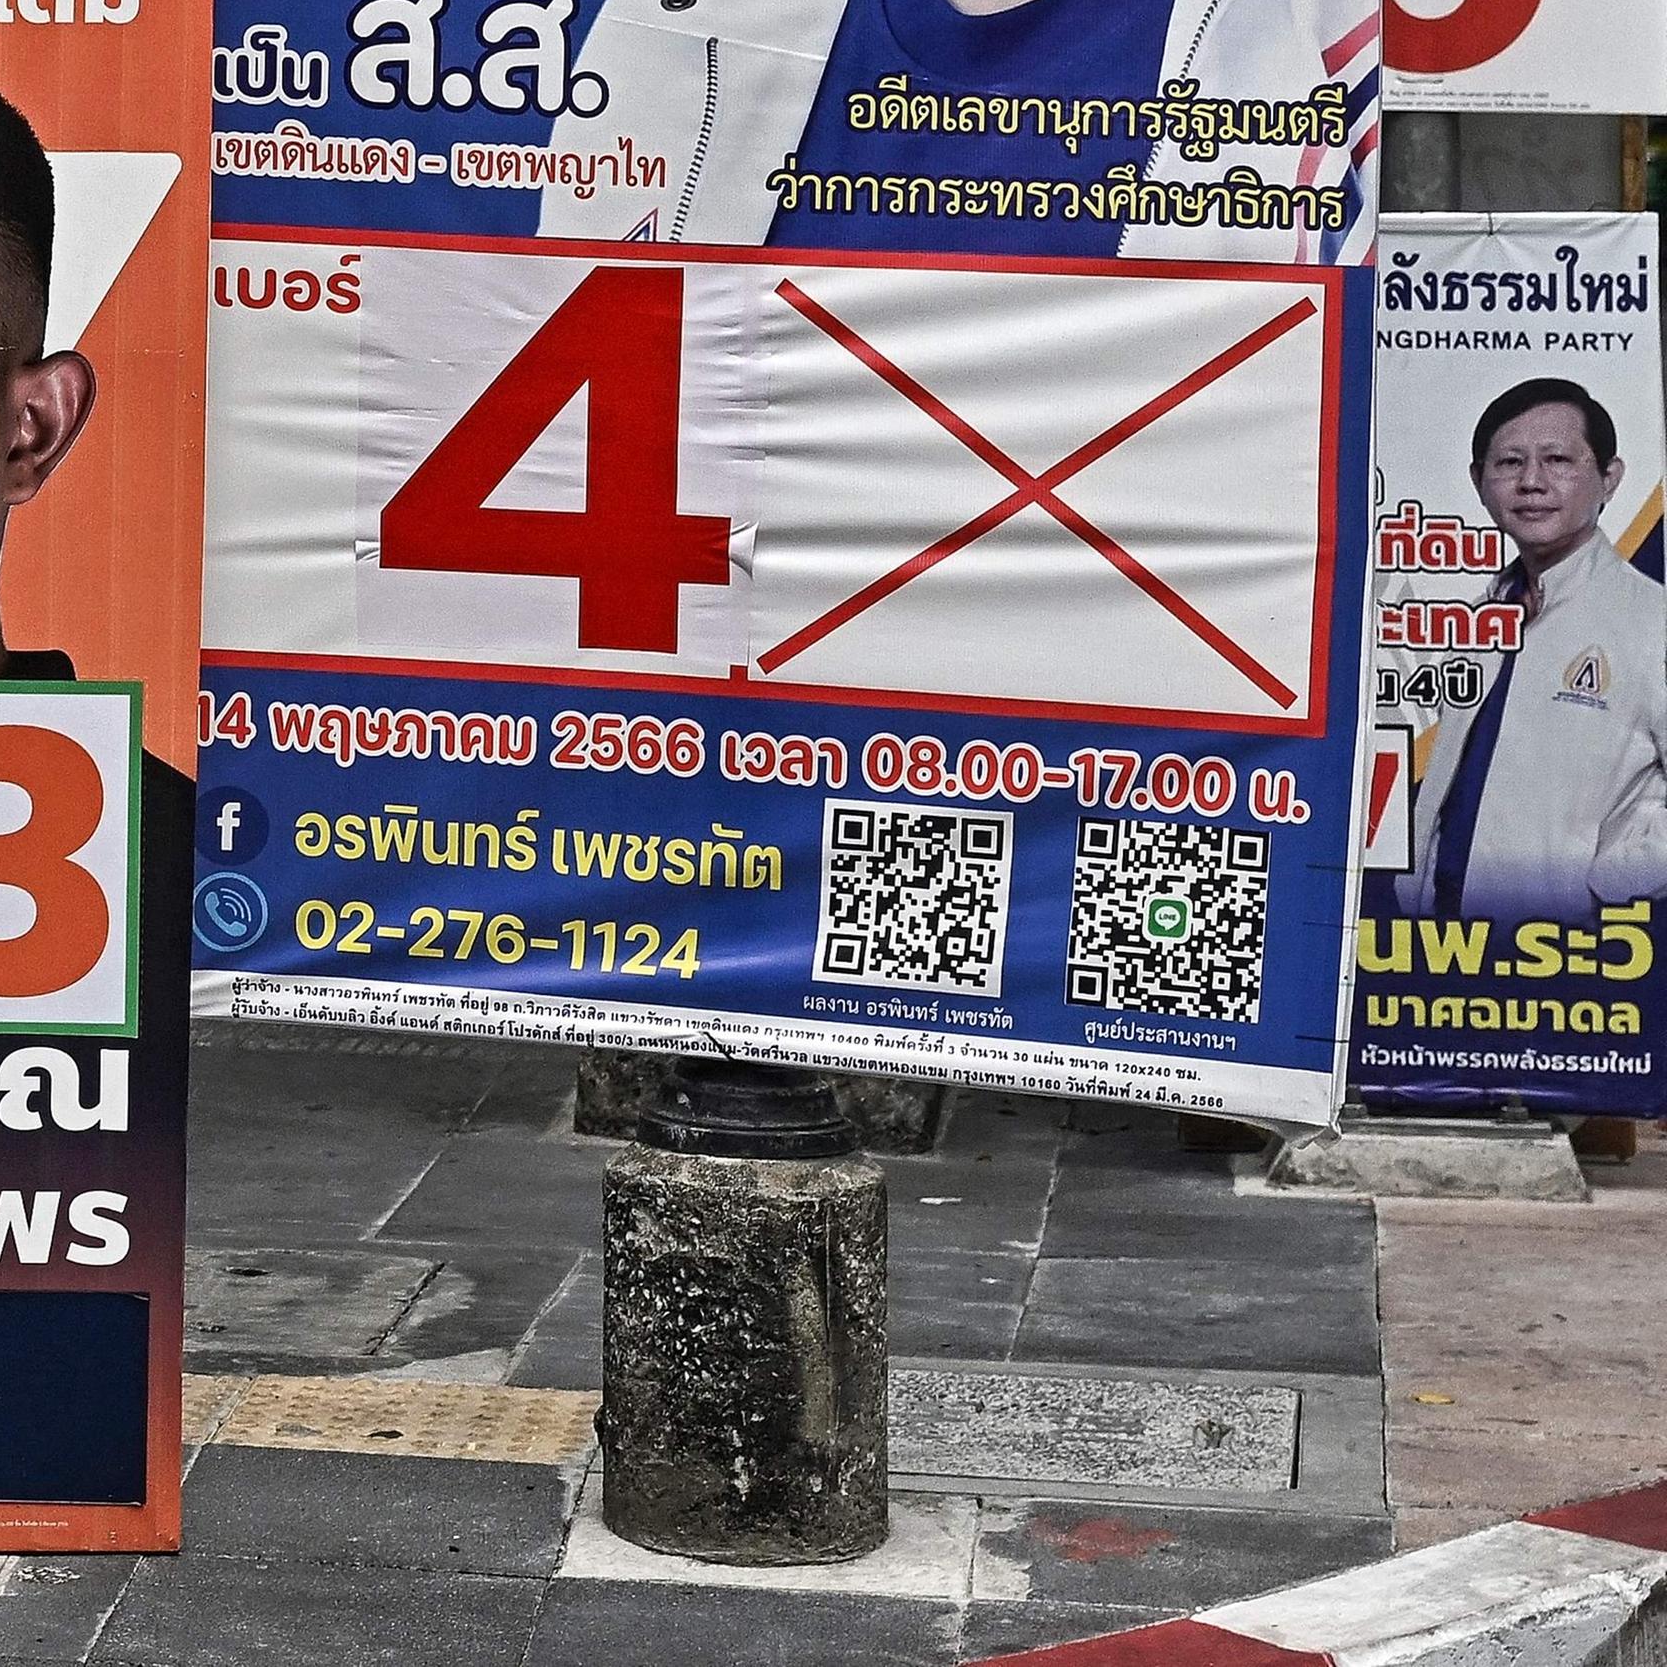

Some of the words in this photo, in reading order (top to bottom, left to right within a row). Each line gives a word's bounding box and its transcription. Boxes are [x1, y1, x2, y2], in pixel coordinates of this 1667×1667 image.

[213, 29, 327, 103] เป็น
[847, 78, 1347, 159] อดีตเลขานุการรัฐมนตรี
[214, 125, 411, 178] เขตดินแดง
[456, 136, 667, 199] เขตพญาไท
[769, 162, 1345, 230] ว่าการกระทรวงศึกษาธิการ
[214, 254, 362, 313] เบอร์
[1377, 245, 1649, 313] ลังธรรมใหม่
[1544, 332, 1634, 352] PARTY
[379, 264, 733, 652] 4
[272, 703, 534, 766] พฤษภาคม
[553, 714, 704, 775] 2566
[725, 731, 845, 786] เวลา
[863, 734, 1234, 815] 08.00-17.00
[1252, 770, 1310, 821] น.
[294, 804, 541, 872] อรพินทร์
[554, 822, 784, 891] เพชรทัต
[295, 899, 702, 979] 02-276-1124
[1357, 899, 1654, 981] นพ.ระวี
[802, 994, 860, 1016] ผลงาน
[866, 998, 939, 1023] อรพินทร์
[944, 1006, 1014, 1030] เพชรทัต
[1083, 1018, 1237, 1052] ศูนย์ประสานงานฯ
